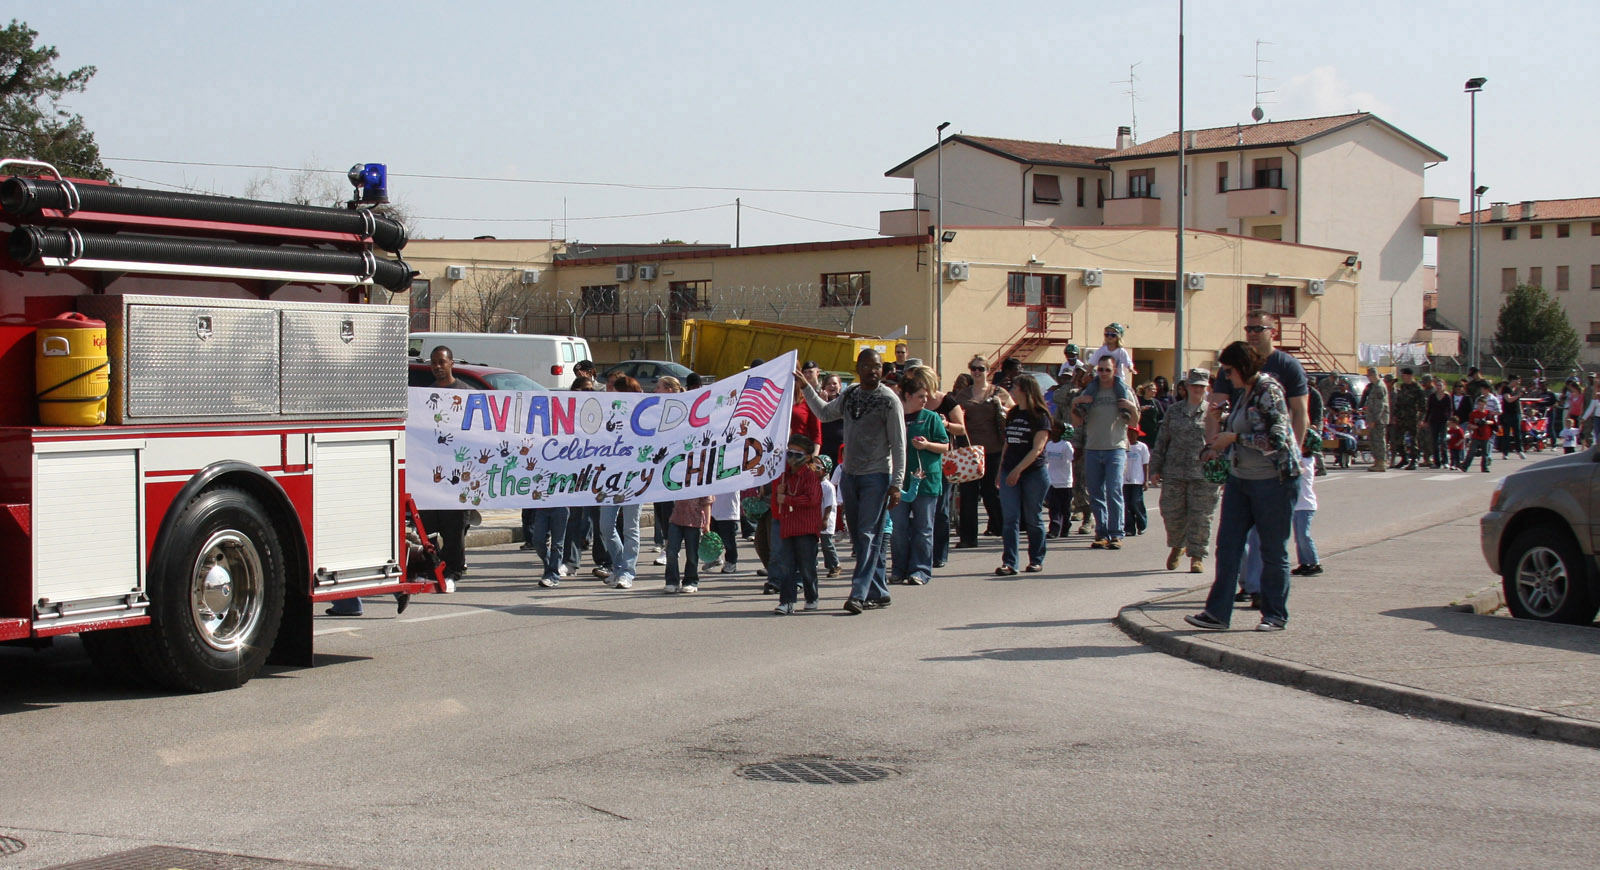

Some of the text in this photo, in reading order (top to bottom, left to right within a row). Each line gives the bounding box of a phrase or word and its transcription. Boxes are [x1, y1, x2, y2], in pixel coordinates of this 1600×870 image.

[630, 390, 712, 437] CDC
[541, 434, 634, 461] Celebrates
[486, 463, 532, 498] the
[546, 463, 655, 498] military
